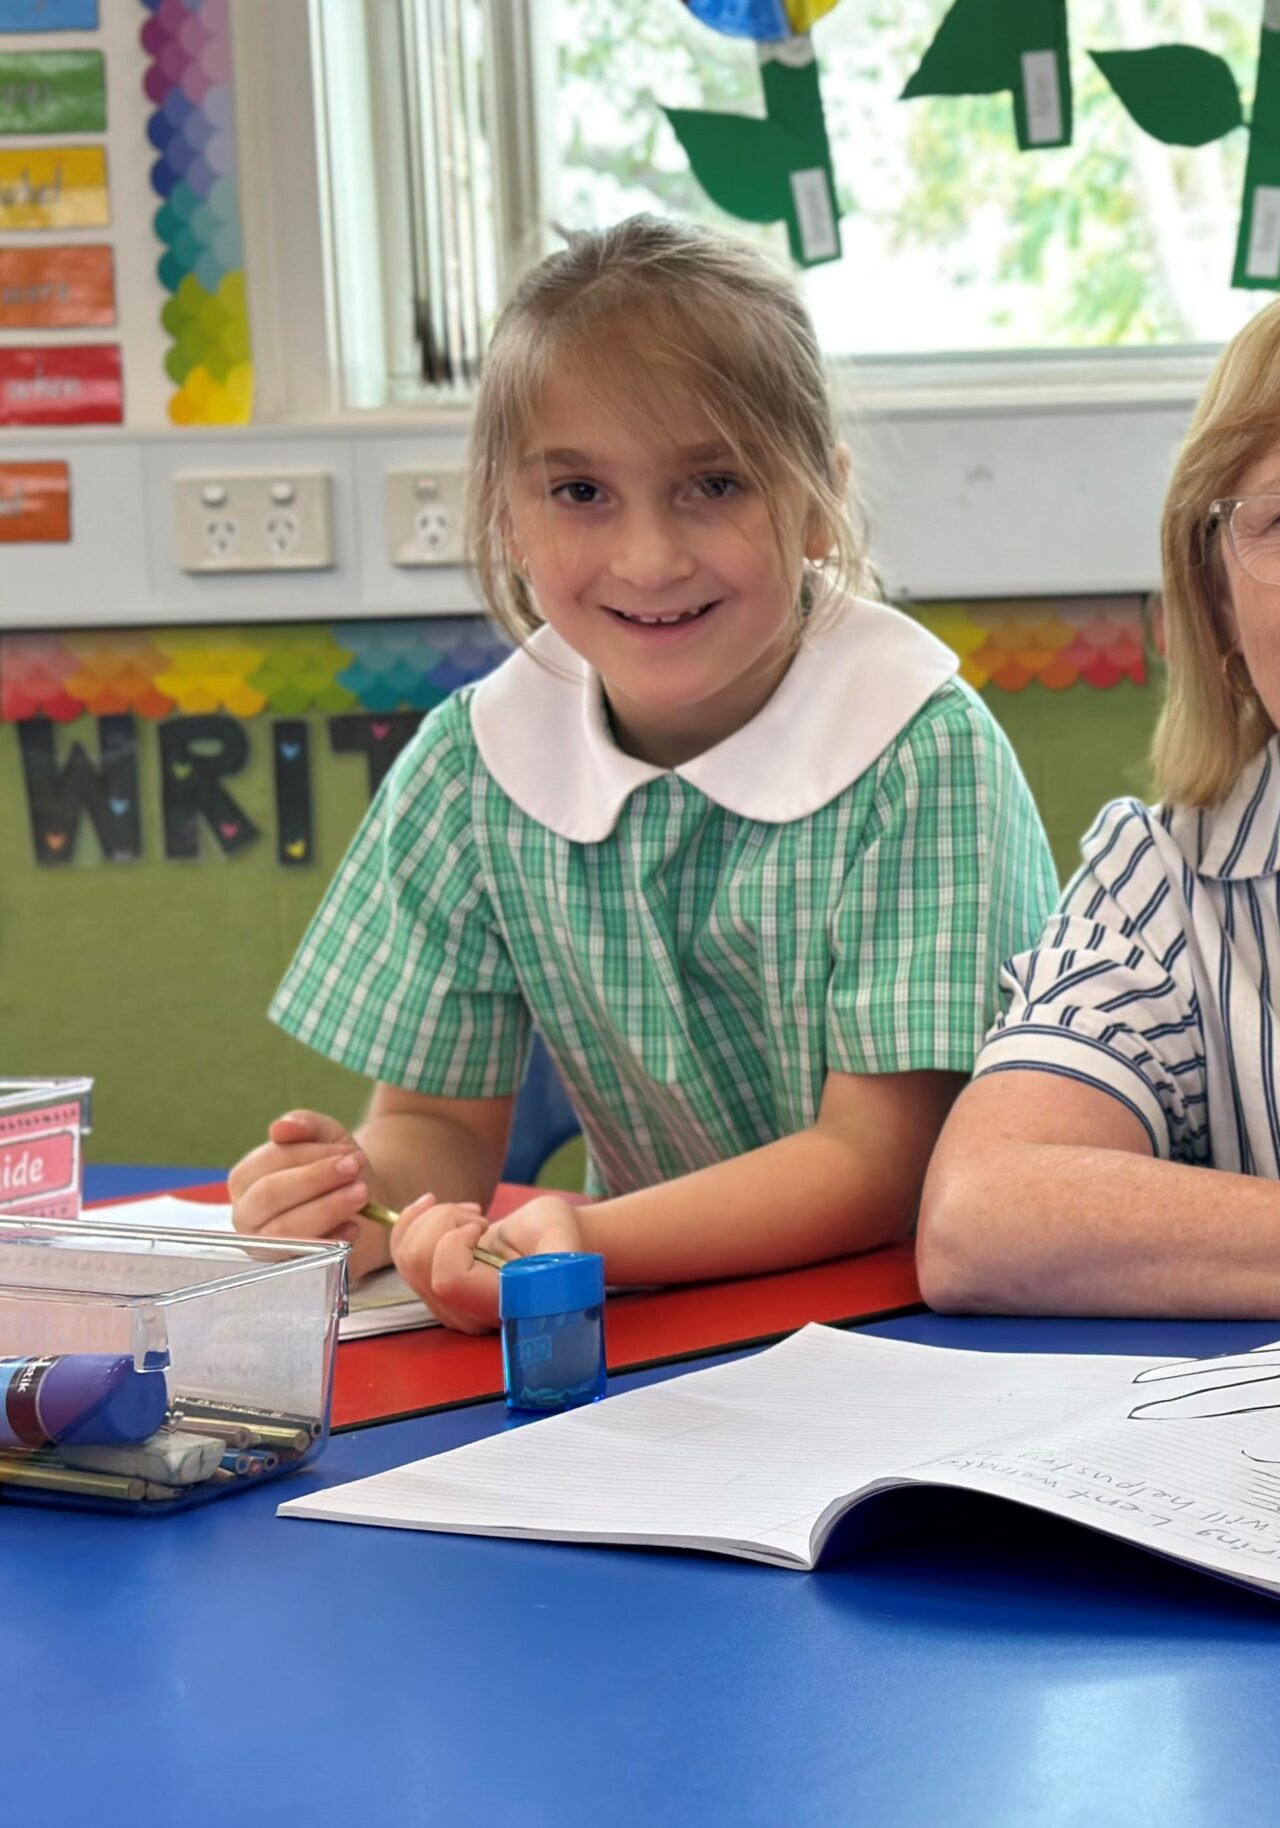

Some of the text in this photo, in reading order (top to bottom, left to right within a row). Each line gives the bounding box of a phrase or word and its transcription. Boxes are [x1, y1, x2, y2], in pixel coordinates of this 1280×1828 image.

[18, 714, 426, 866] WRIT
[0, 1151, 44, 1190] ide
[1067, 1489, 1173, 1527] Lent
[1201, 1511, 1270, 1531] will
